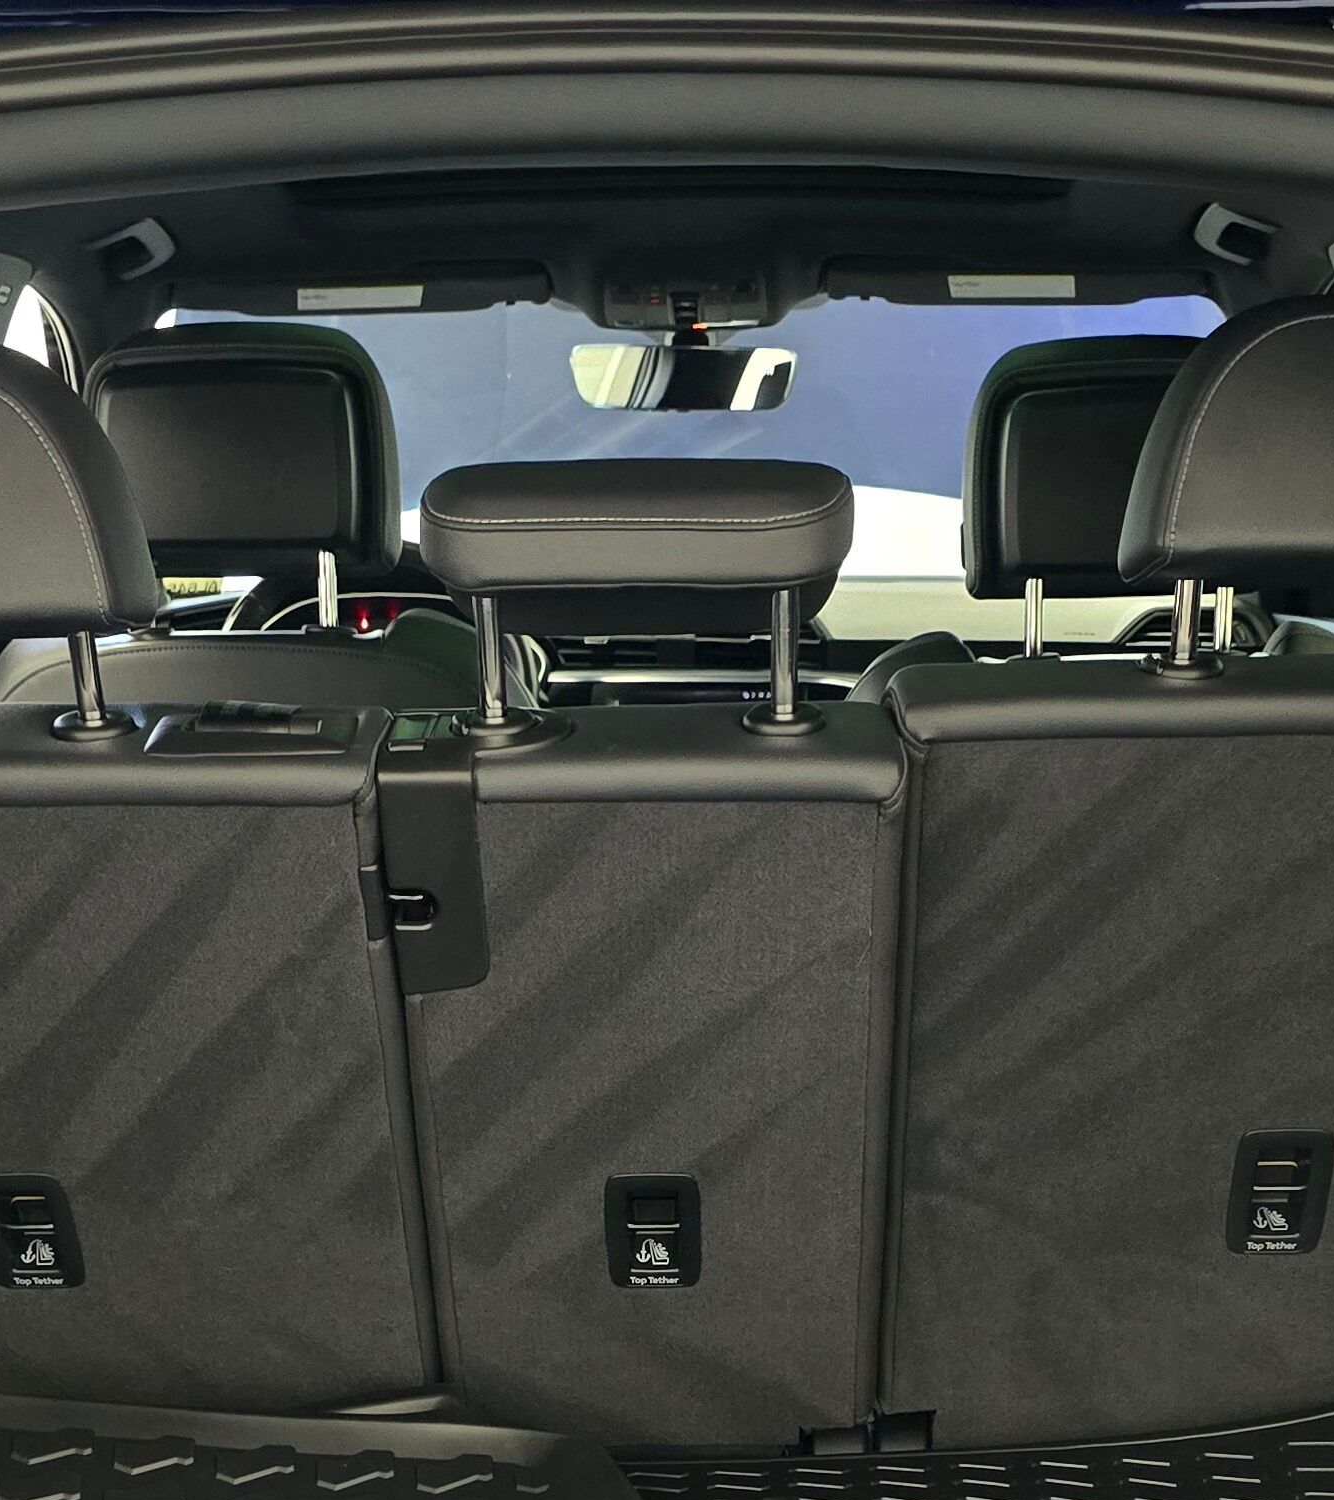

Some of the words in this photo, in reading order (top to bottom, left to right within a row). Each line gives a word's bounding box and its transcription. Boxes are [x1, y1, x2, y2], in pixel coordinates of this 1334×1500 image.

[1246, 1241, 1264, 1251] Top
[1266, 1241, 1297, 1250] Tether
[13, 1277, 32, 1286] Top
[33, 1276, 64, 1285] Tether
[630, 1276, 647, 1286] Top
[648, 1276, 679, 1284] Tether
